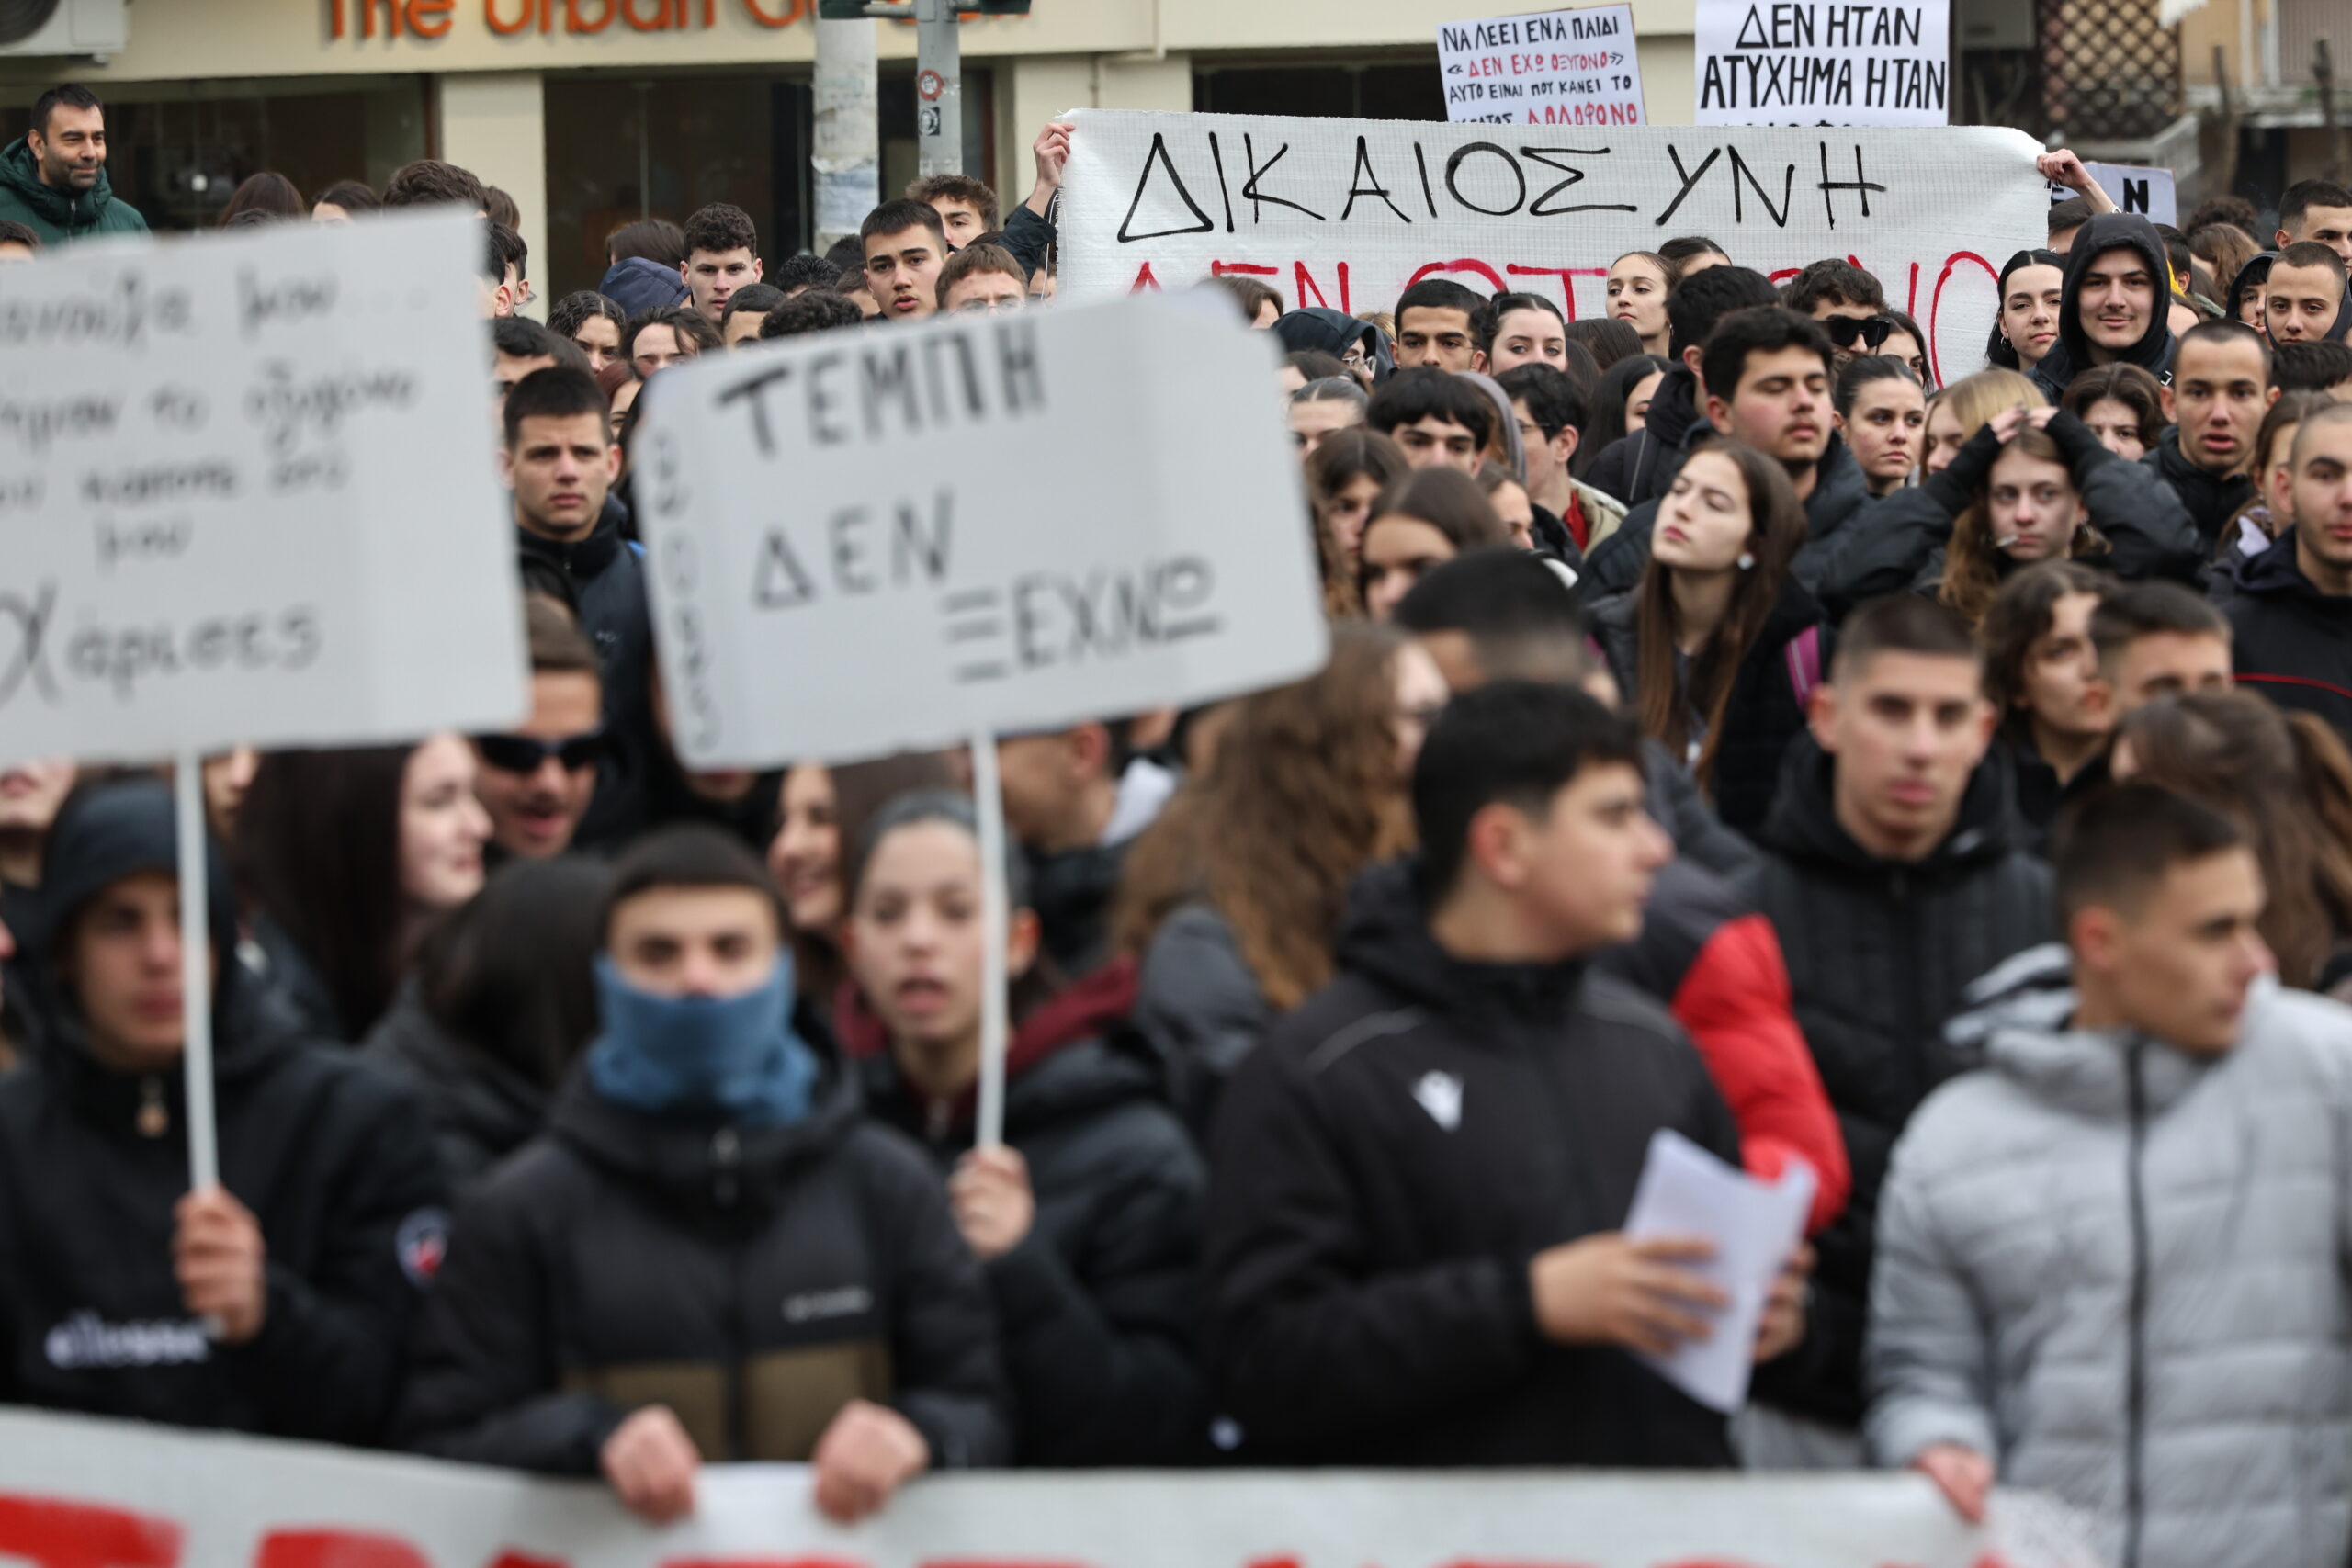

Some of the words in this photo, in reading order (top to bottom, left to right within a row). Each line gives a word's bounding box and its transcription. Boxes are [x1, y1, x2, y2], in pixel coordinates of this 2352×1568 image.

[1442, 27, 1472, 52] ΝΑ
[1475, 22, 1520, 50] ΛΕΕΙ
[1526, 17, 1567, 44] ΕΝΑ
[1572, 16, 1620, 40] ΠΑΙΔΙ
[1735, 4, 1815, 49] ΔΕΝ
[1826, 6, 1921, 47] ΗΤΑΝ
[1449, 83, 1484, 104] ΑΥΤΟ
[1489, 84, 1523, 99] ΕΙΝΑΙ
[1559, 79, 1601, 95] ΚΑΝΕΙ
[1611, 75, 1632, 90] ΤΟ
[1510, 53, 1544, 75] ΕΧΩ
[1700, 55, 1852, 109] ΑΤΥΧΗΜΑ
[1865, 57, 1945, 110] ΗΤΑΝ
[1118, 131, 1886, 243] ΔΙΚΑΙΟΣΥΝΗ
[715, 317, 1047, 458] ΤΕΜΠΗ
[752, 485, 954, 610] ΔΕΝ
[941, 555, 1227, 685] ΞΕΧΝΩ
